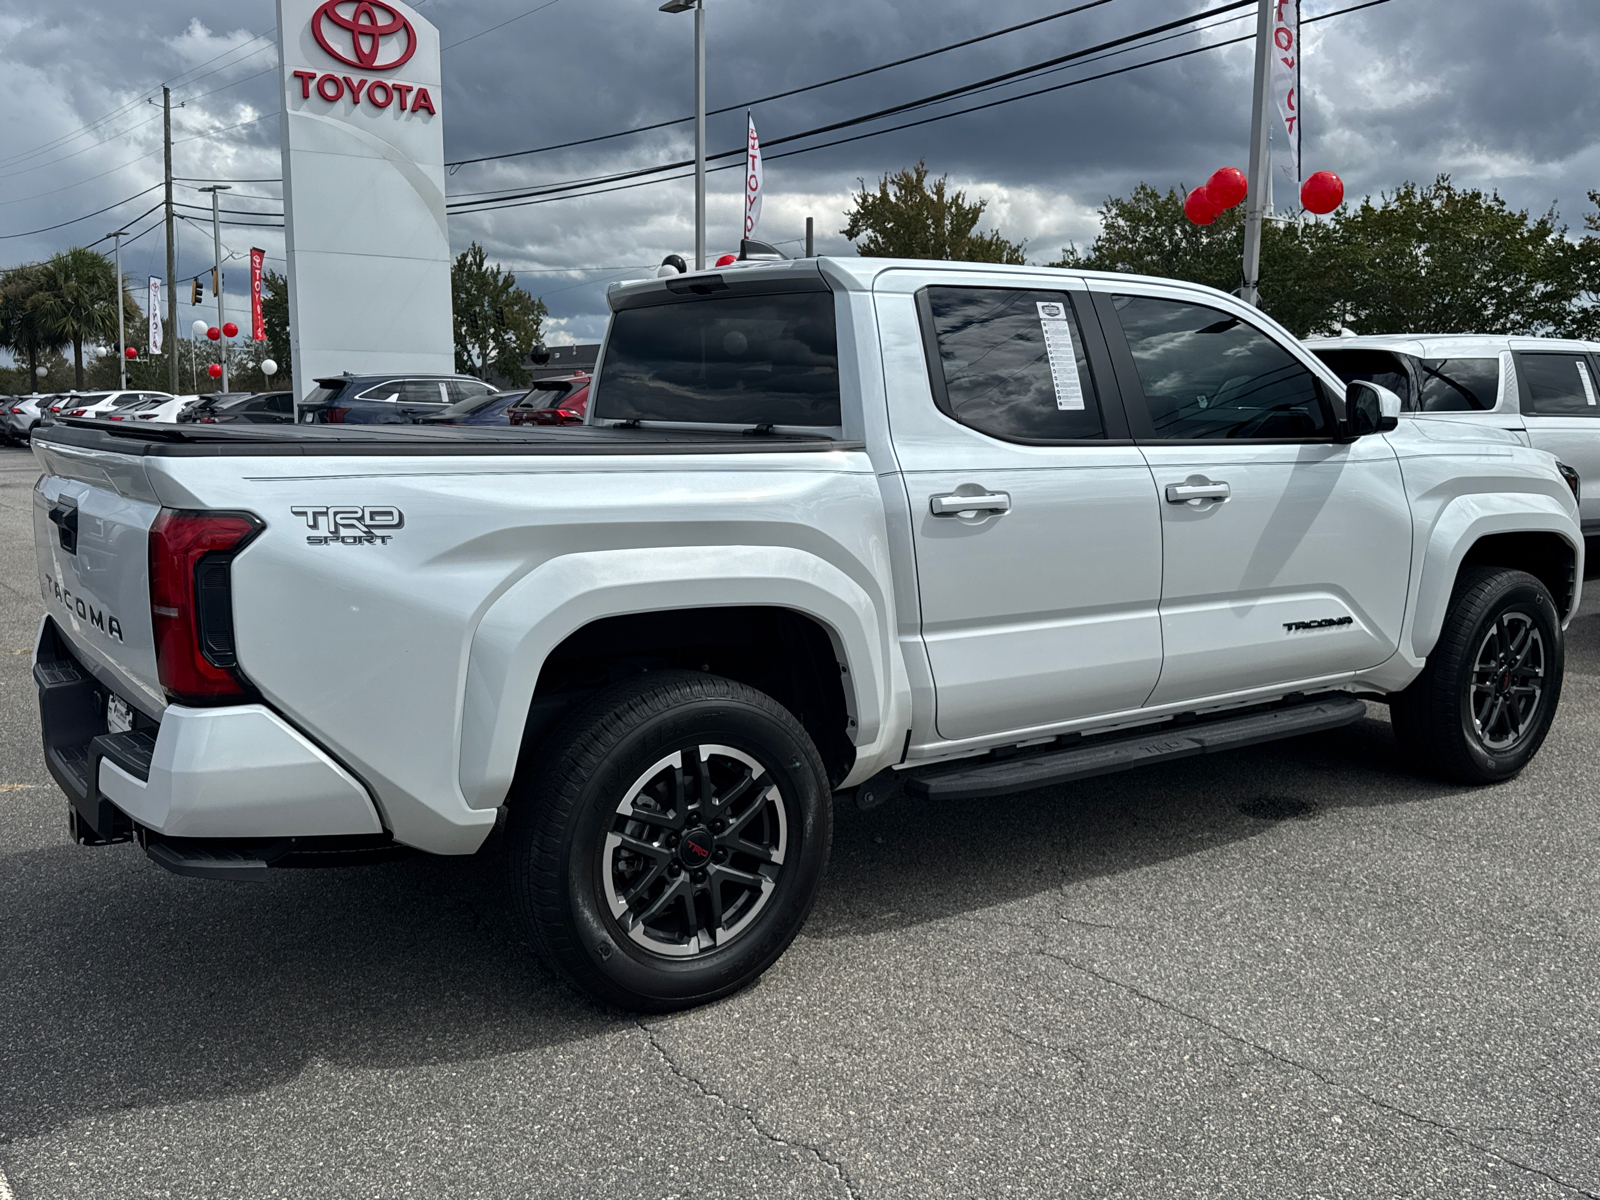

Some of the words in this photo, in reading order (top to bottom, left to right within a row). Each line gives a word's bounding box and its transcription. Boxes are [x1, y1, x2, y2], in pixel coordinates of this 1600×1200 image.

[293, 70, 436, 115] TOYOTA
[744, 154, 759, 240] TOYO
[290, 505, 405, 537] TRD
[306, 535, 393, 546] SPORT
[45, 573, 124, 644] TACOMA
[1282, 615, 1354, 632] TACOMA
[687, 840, 709, 858] TRD
